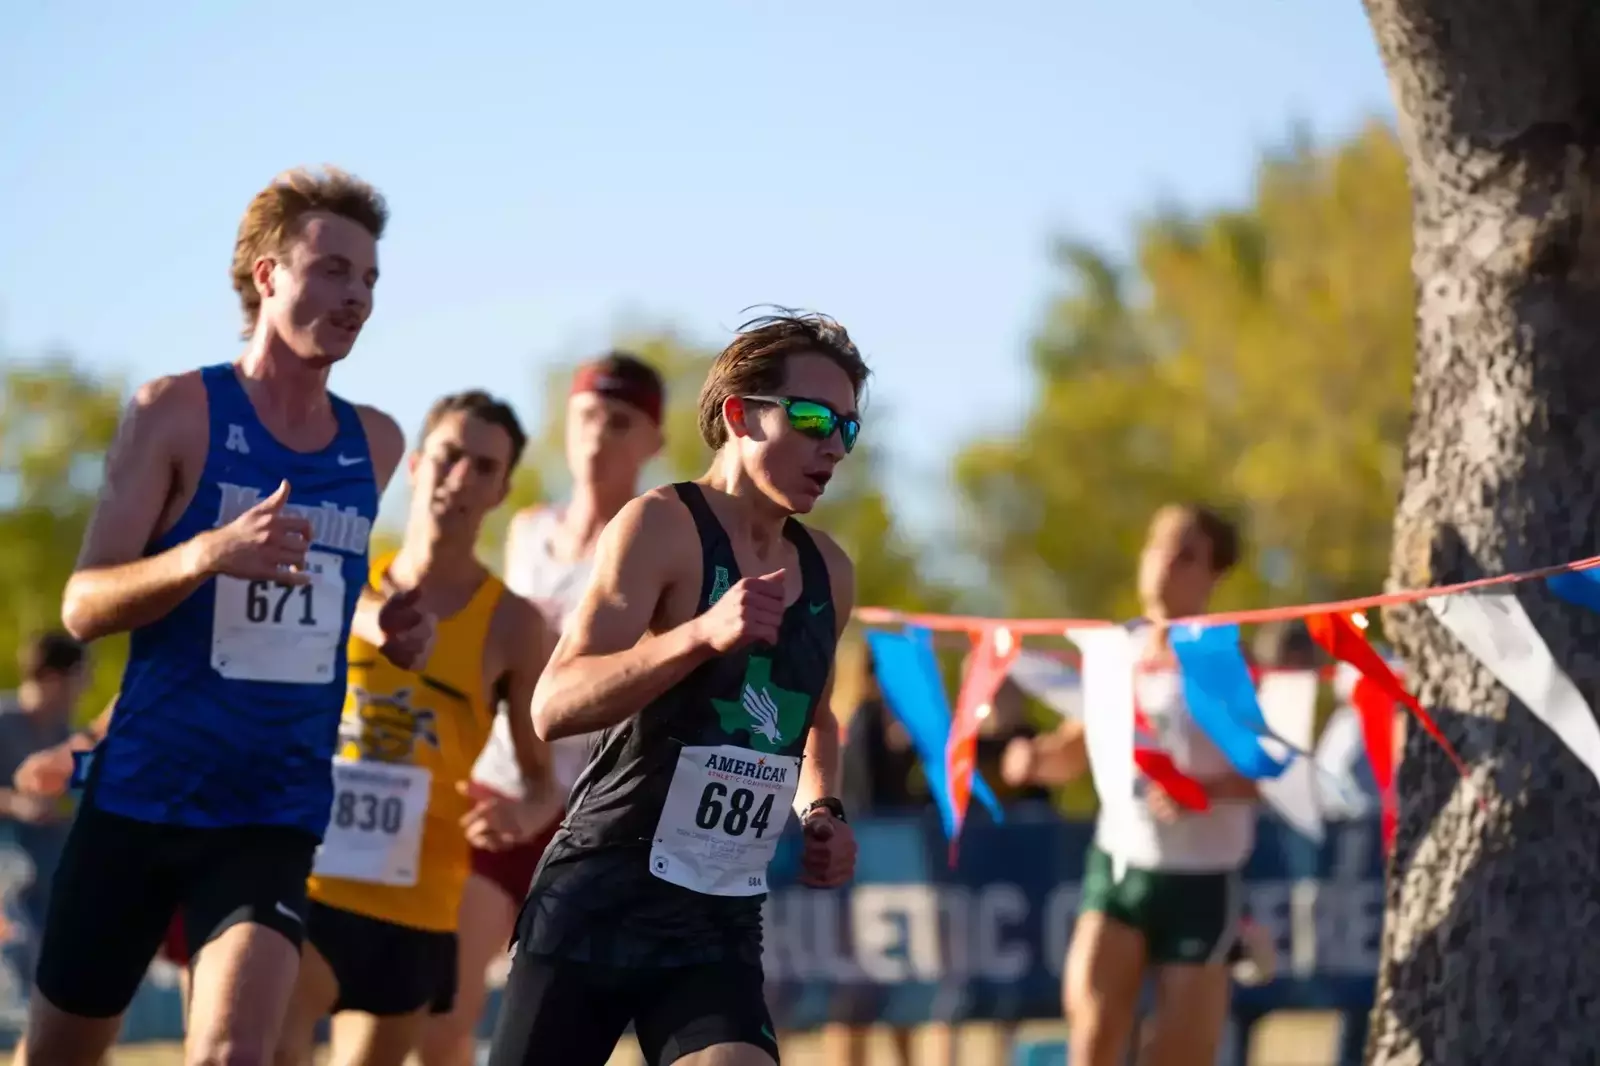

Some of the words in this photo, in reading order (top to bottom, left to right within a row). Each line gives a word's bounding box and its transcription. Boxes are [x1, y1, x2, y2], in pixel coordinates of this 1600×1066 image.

[225, 423, 250, 454] A
[213, 482, 371, 556] Mphis
[246, 579, 317, 625] 671
[704, 753, 787, 783] AMERICAN
[335, 792, 404, 833] 830
[695, 781, 775, 839] 684
